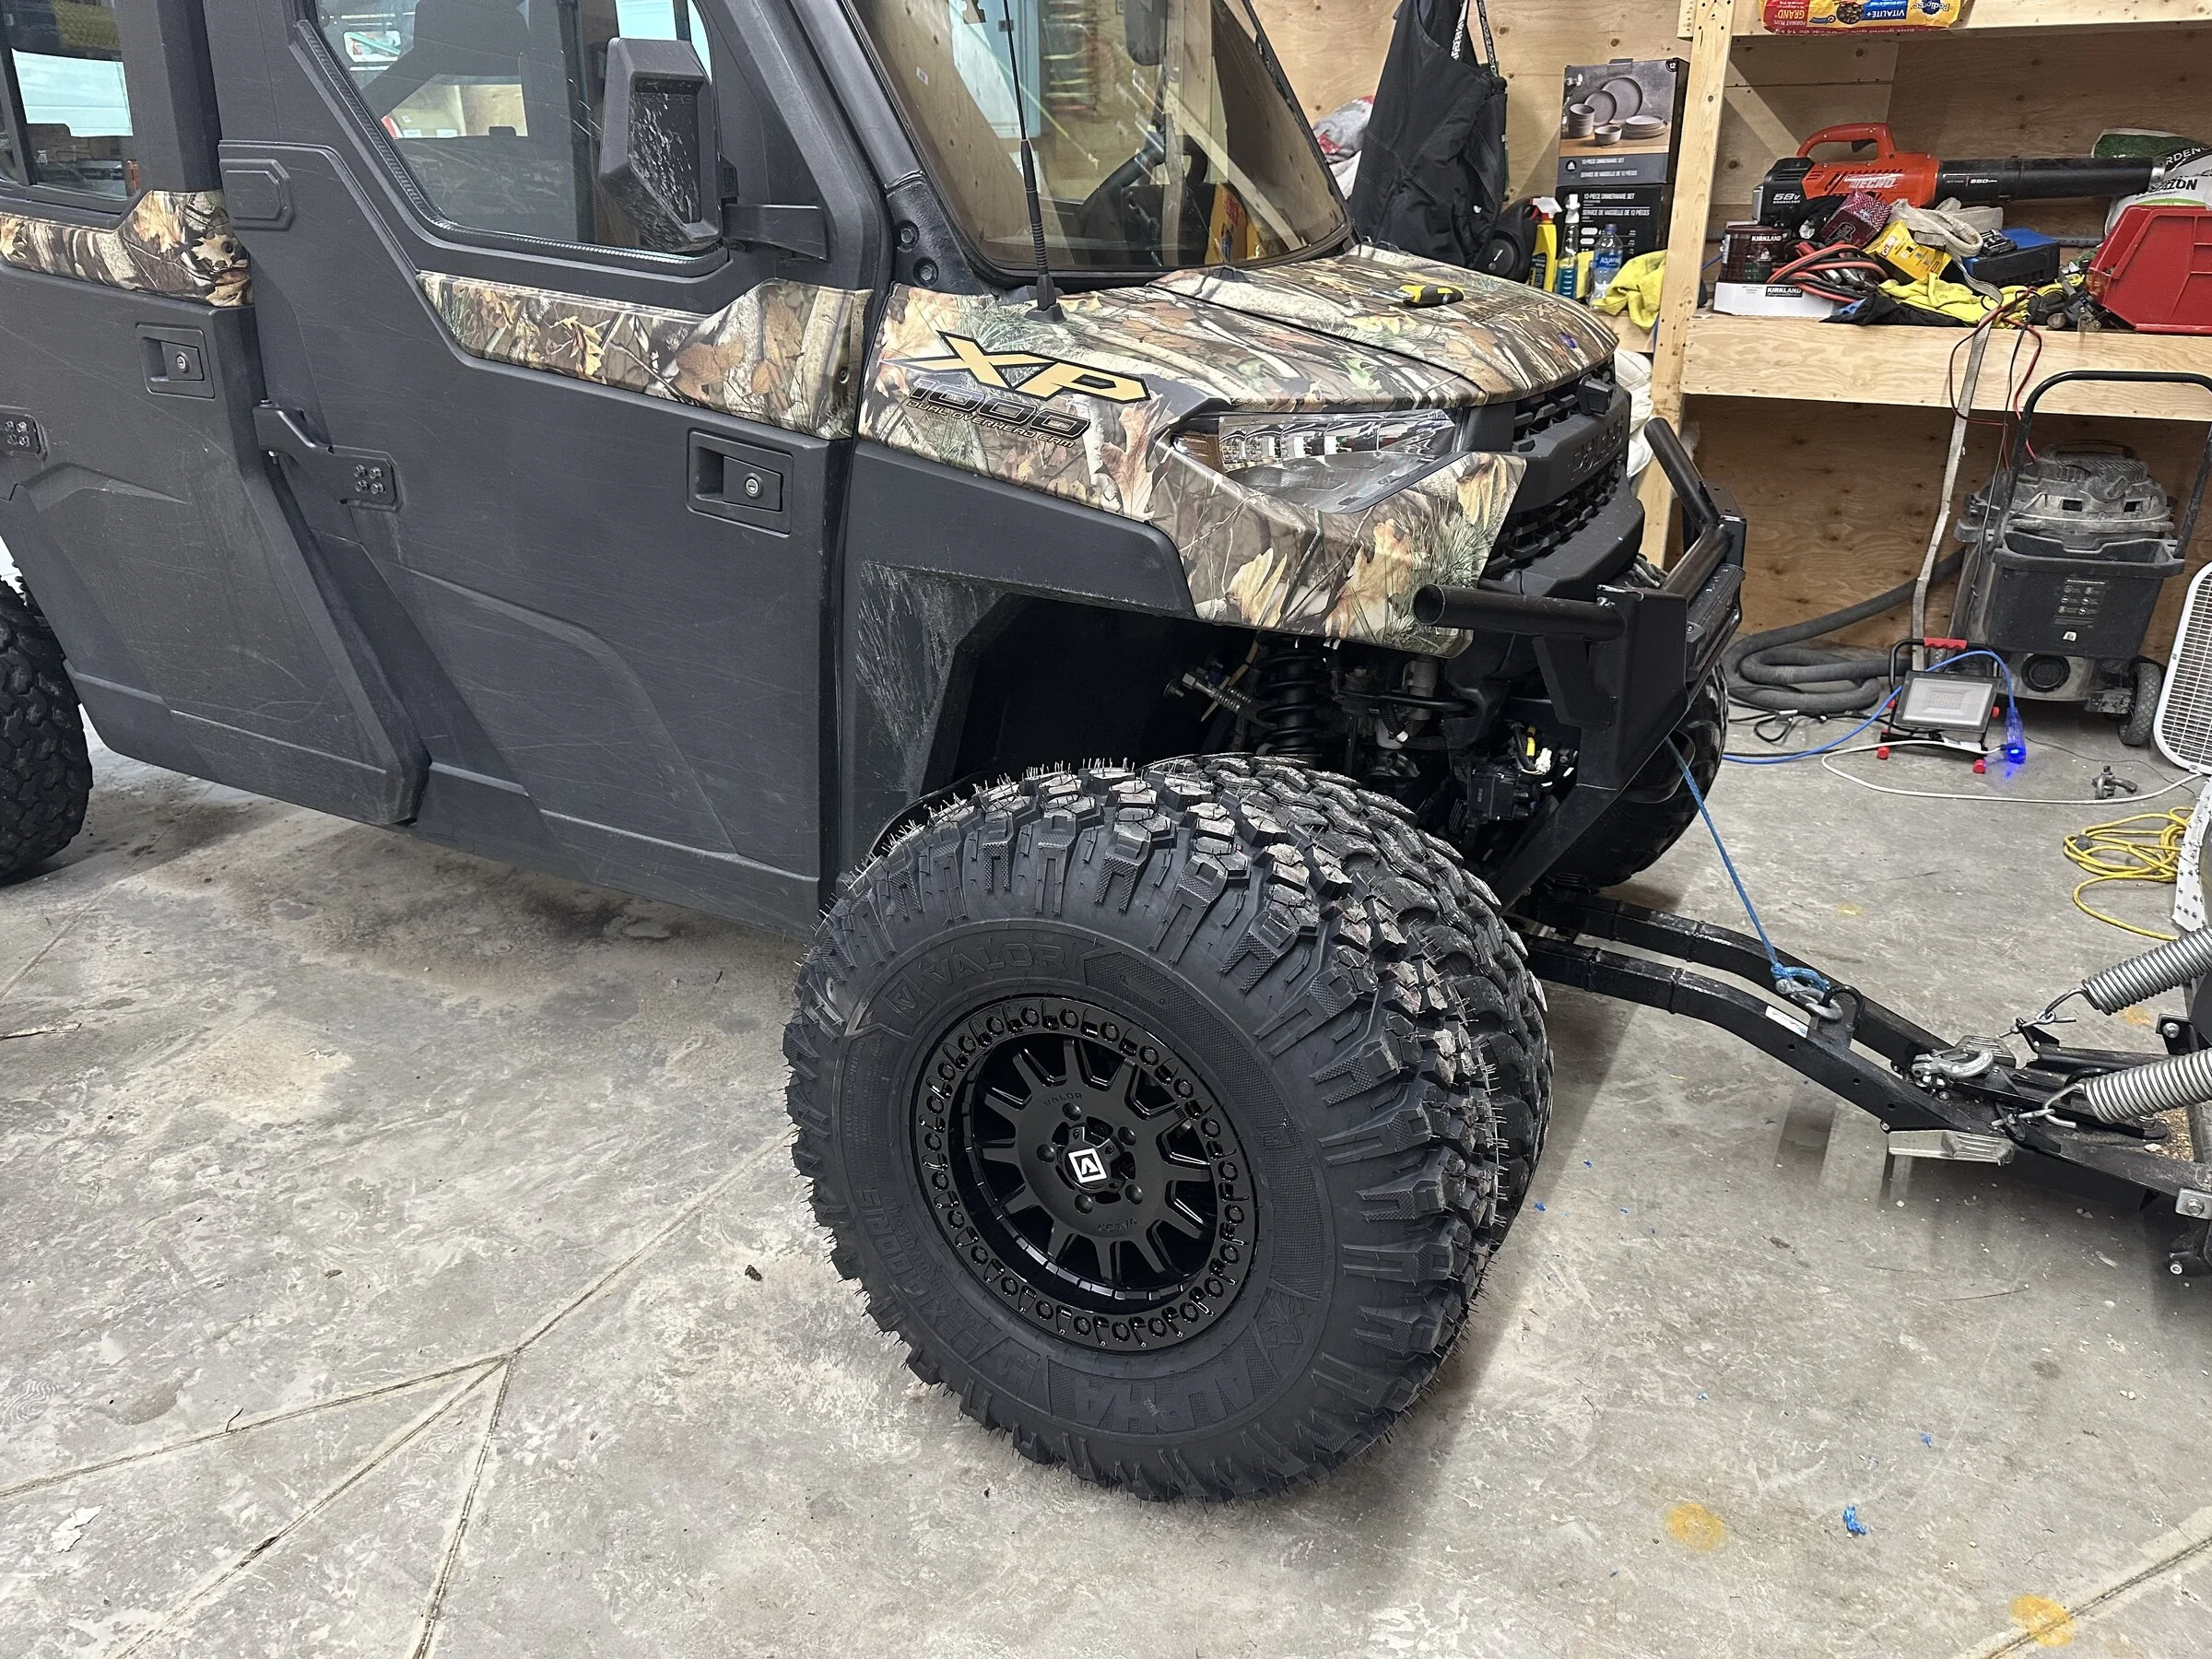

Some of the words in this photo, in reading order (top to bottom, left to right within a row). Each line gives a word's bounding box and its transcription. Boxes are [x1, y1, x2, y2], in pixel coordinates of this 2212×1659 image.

[1767, 286, 1802, 294] KIRKLAND
[887, 330, 1152, 404] XP
[907, 400, 948, 418] DUAL
[951, 410, 1037, 441] OVERHEAD
[1037, 432, 1076, 448] CAM
[909, 378, 1090, 441] 1000
[1043, 1092, 1083, 1106] VALOR
